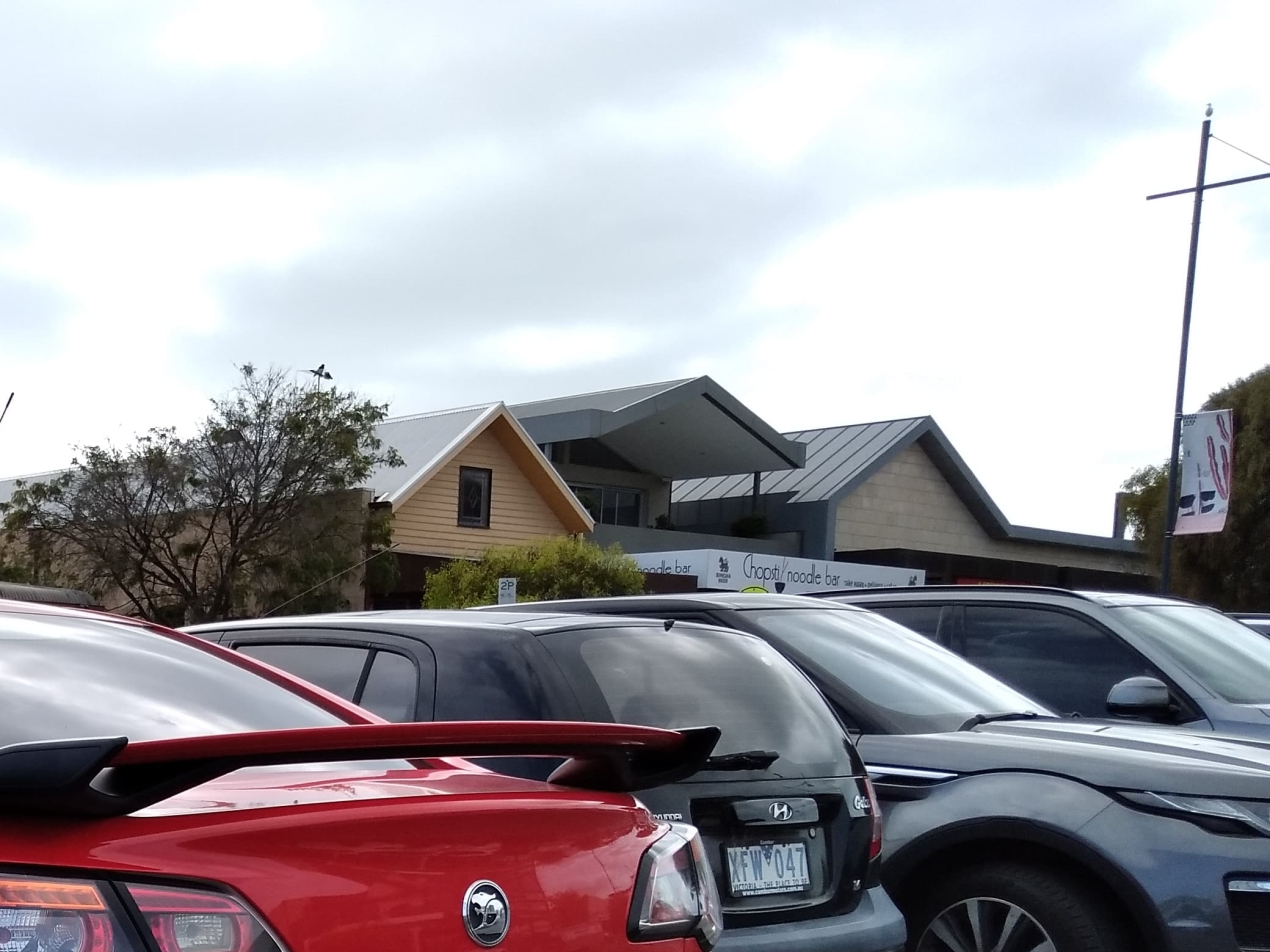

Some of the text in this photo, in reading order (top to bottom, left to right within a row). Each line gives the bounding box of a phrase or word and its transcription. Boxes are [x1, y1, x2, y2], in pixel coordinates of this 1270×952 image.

[675, 559, 691, 574] bar
[787, 564, 822, 585] noodle
[825, 565, 841, 586] bar
[501, 581, 514, 590] 2P
[729, 847, 804, 882] XFW 047
[733, 882, 757, 891] VICTORIA
